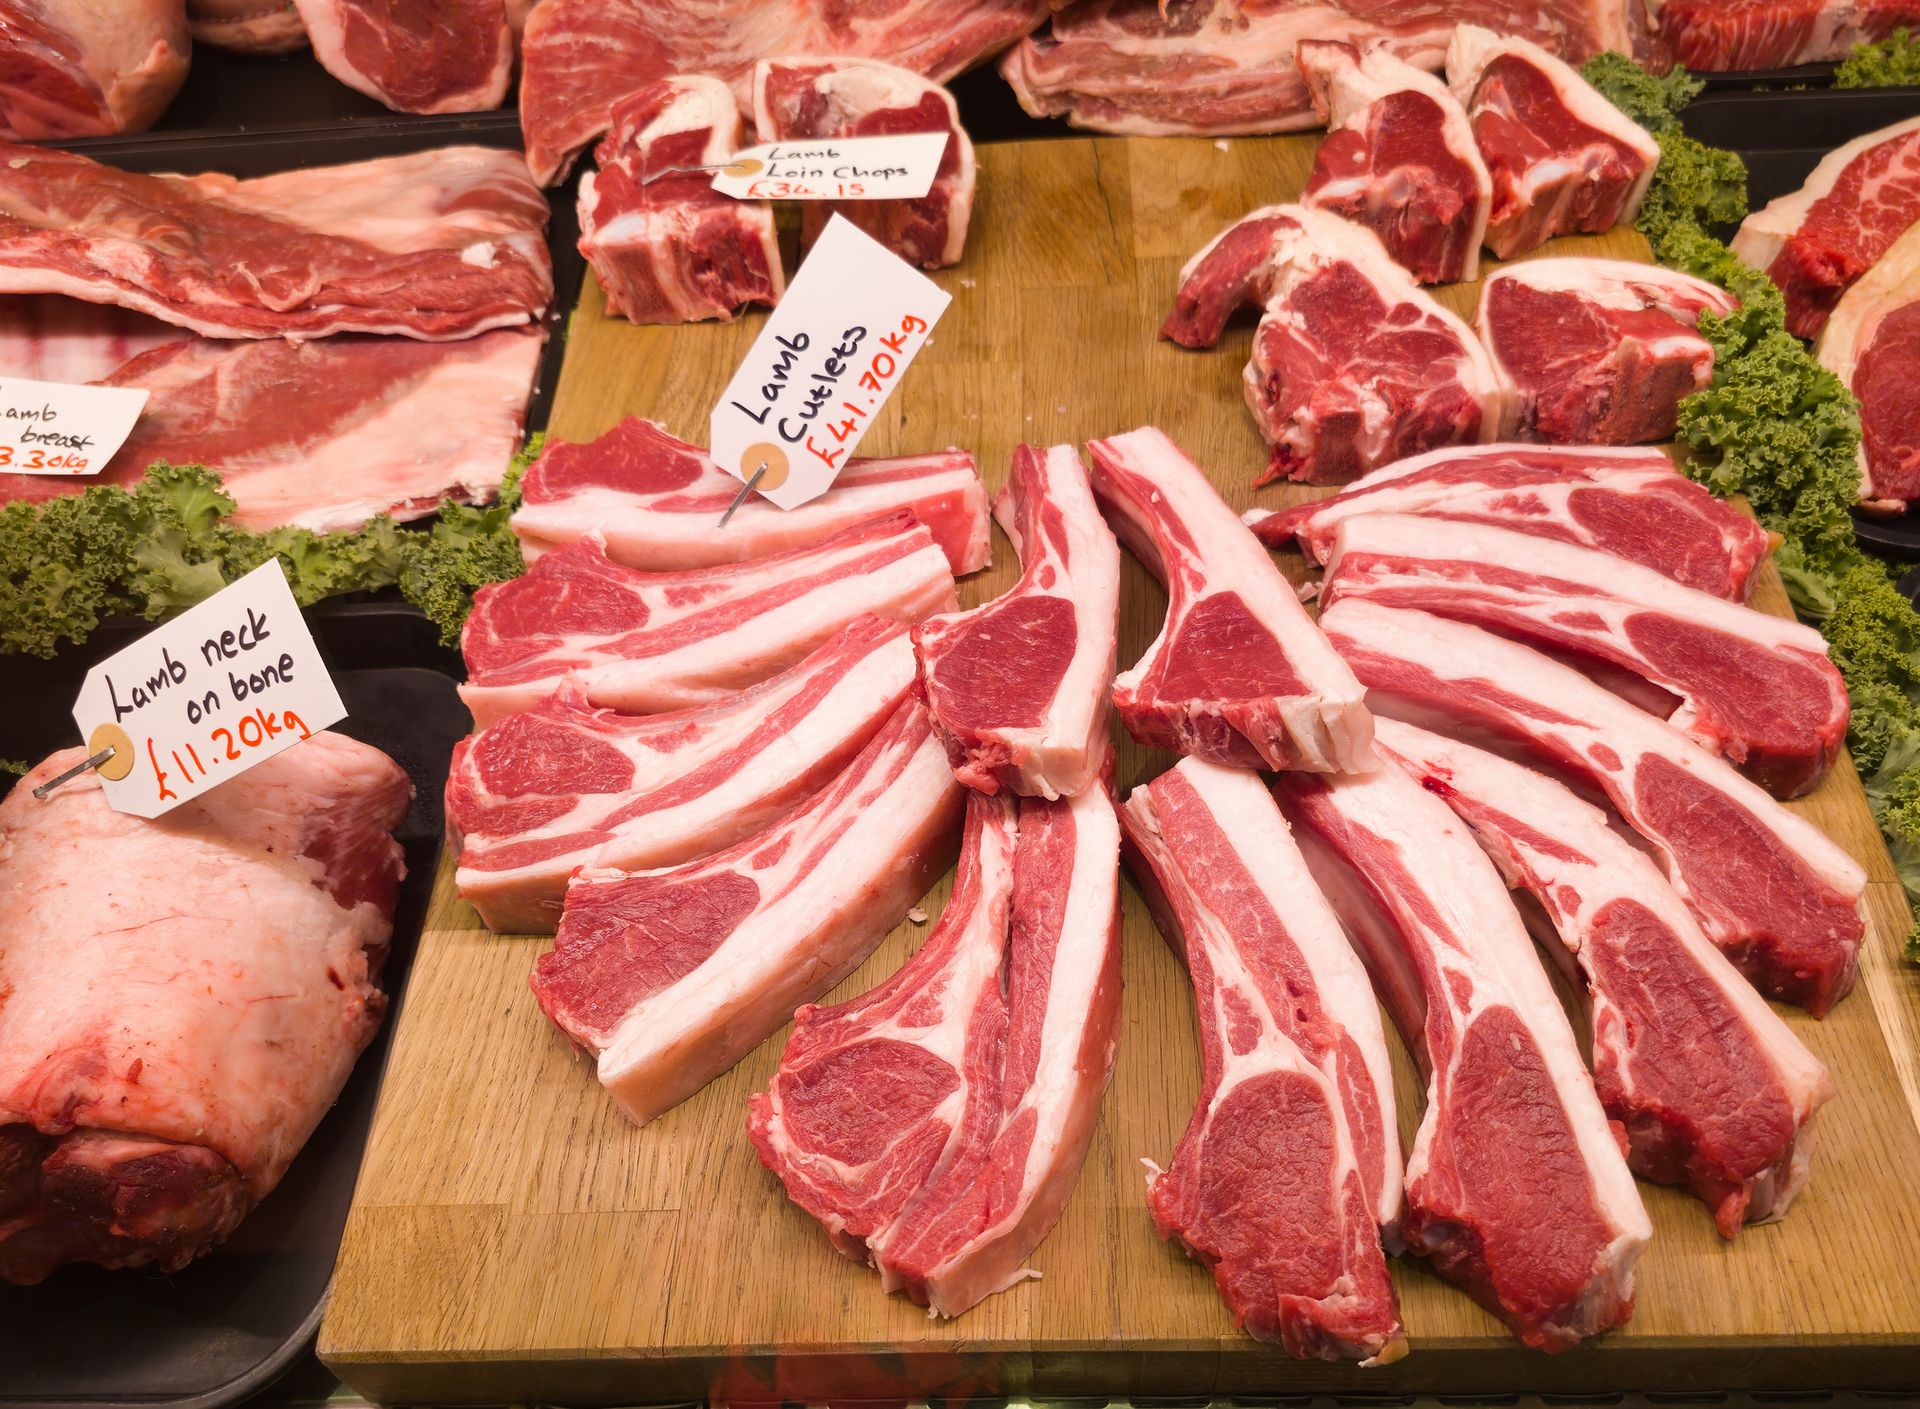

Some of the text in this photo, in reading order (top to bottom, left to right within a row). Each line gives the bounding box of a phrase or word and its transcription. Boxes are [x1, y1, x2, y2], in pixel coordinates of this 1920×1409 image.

[747, 180, 865, 198] £34.15
[766, 163, 909, 180] Loin Chops
[768, 147, 840, 161] Lamb
[0, 403, 57, 422] amb
[731, 332, 810, 425] Lamb
[778, 326, 867, 443] Cutlets
[806, 315, 928, 469] £41.70kg
[20, 425, 95, 451] breast
[105, 607, 270, 723] Lamb neck
[187, 653, 294, 724] on bone
[147, 707, 311, 801] £11.20kg
